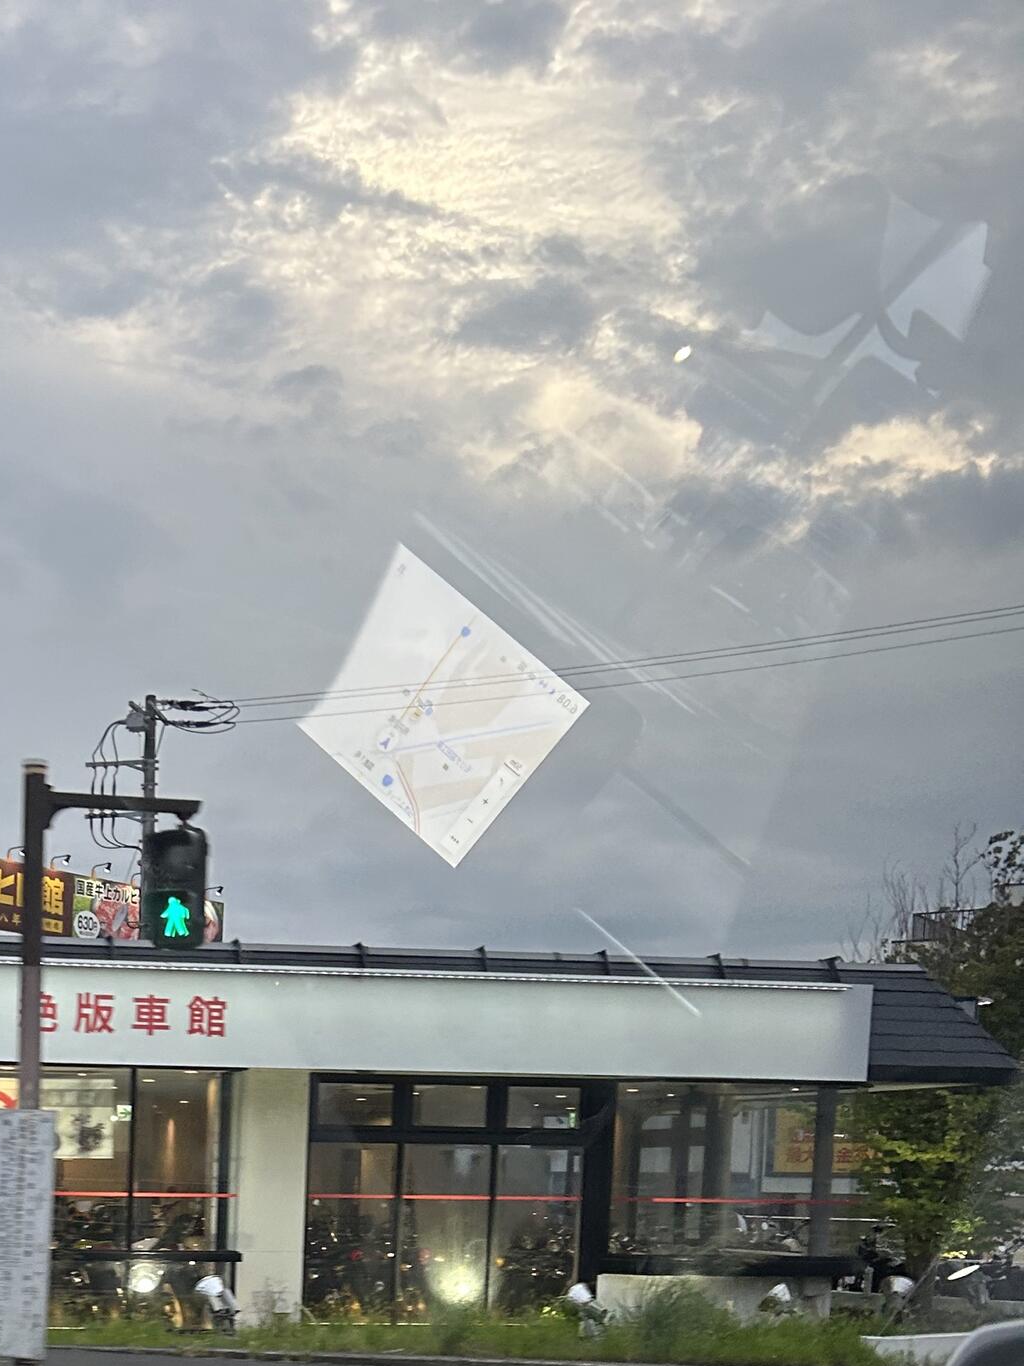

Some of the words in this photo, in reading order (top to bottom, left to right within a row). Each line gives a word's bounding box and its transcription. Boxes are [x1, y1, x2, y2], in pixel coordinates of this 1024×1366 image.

[76, 879, 141, 905] 国産牛上カルビ
[78, 914, 98, 931] 630円
